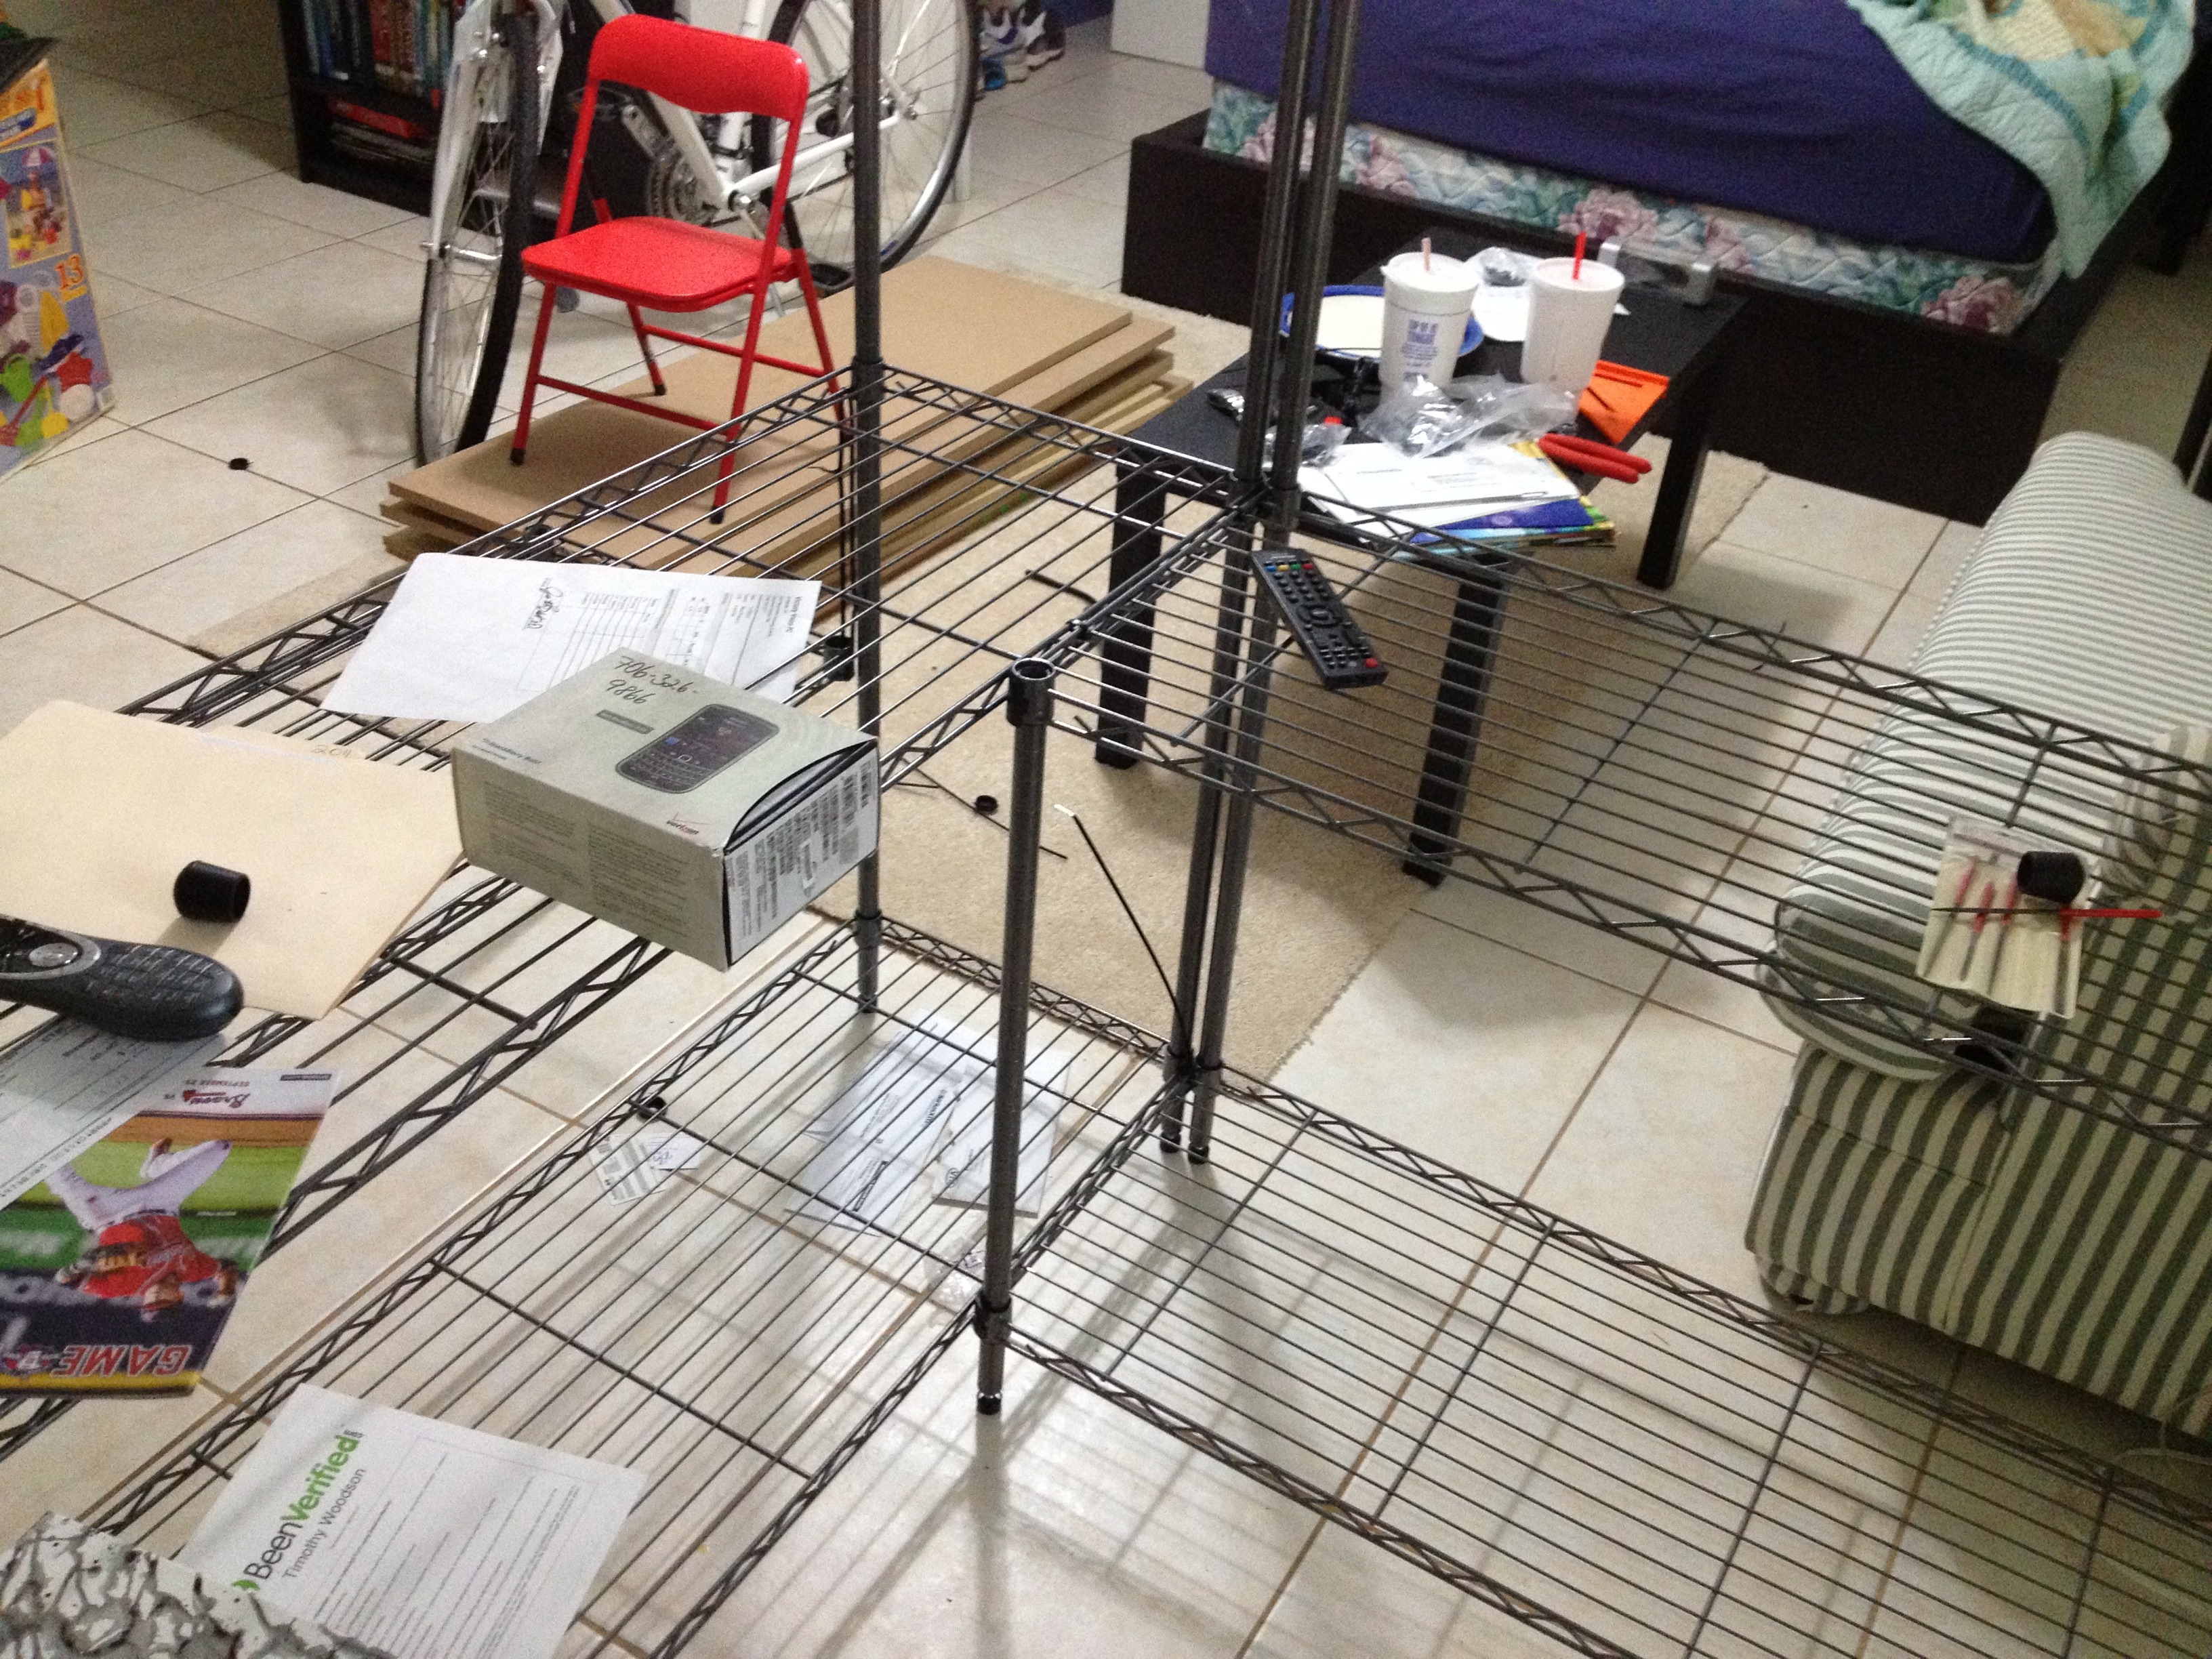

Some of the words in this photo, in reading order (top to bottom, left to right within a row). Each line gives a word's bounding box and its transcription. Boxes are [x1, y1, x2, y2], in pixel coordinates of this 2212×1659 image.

[55, 253, 83, 290] 13
[606, 679, 656, 703] 9866
[50, 1344, 193, 1377] GAME
[243, 1434, 360, 1580] BeenVerified
[282, 1528, 327, 1578] Timothy
[318, 1467, 367, 1525] Woodson
